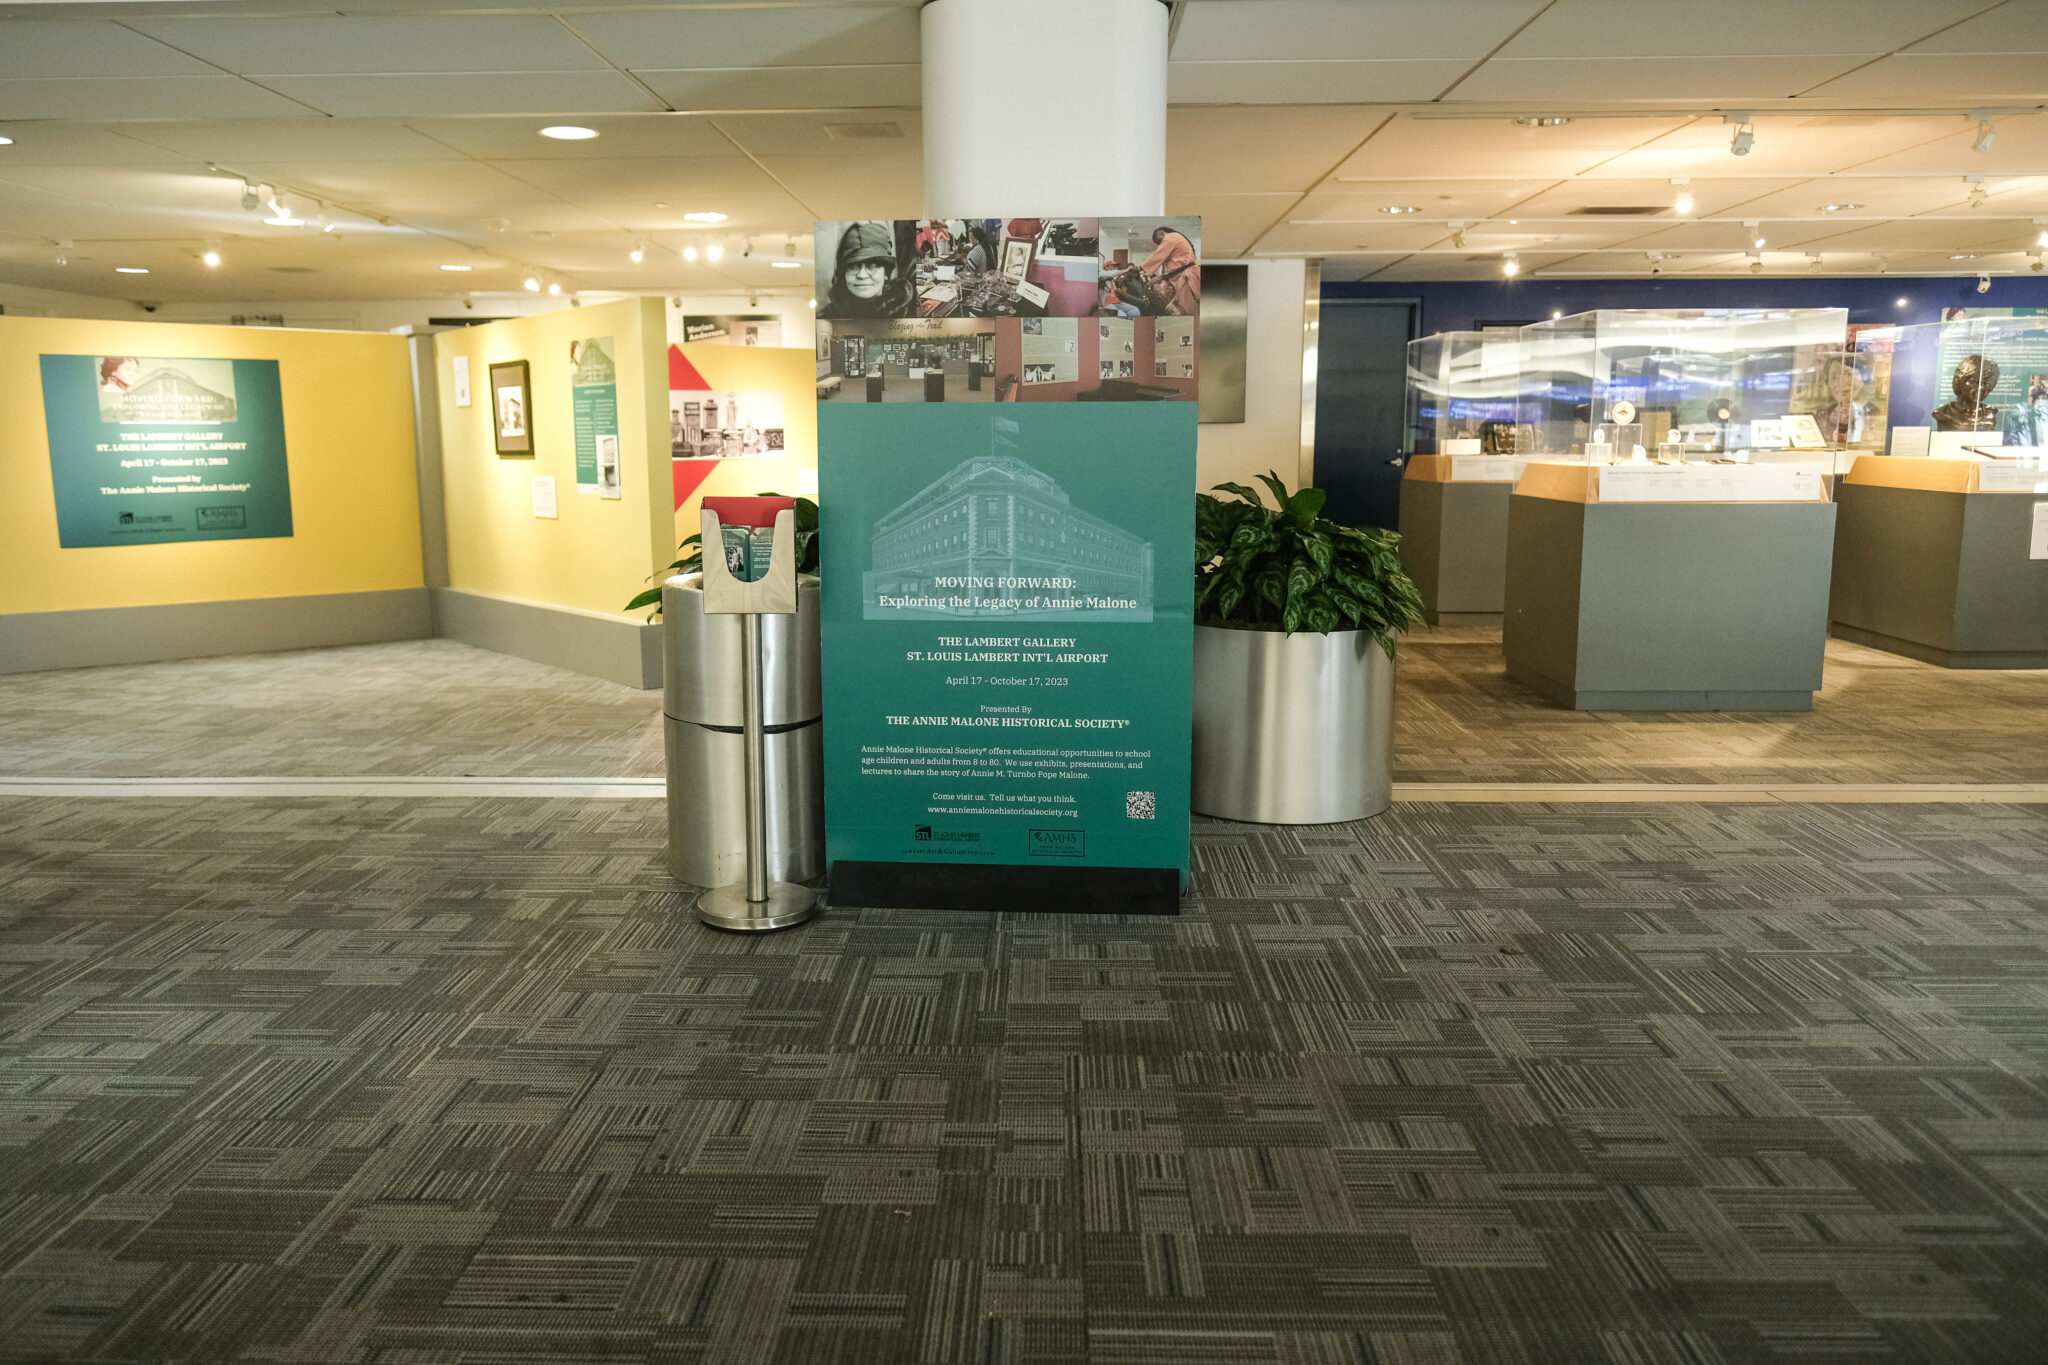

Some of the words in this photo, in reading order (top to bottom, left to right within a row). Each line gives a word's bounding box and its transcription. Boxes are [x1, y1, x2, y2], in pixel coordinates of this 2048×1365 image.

[687, 324, 715, 334] Marian
[888, 319, 914, 332] Blazing
[925, 319, 943, 329] Trail
[689, 329, 726, 341] Anderson
[120, 433, 141, 441] THE
[141, 433, 183, 441] LAMBERT
[184, 432, 223, 440] GALLERY
[96, 444, 112, 452] ST.
[141, 443, 184, 451] LAMBERT
[209, 442, 247, 450] AIRPORT
[121, 459, 143, 468] April
[144, 459, 154, 467] 17
[161, 458, 193, 467] October
[195, 458, 208, 467] 17,
[152, 475, 191, 483] Presented
[191, 475, 201, 483] by
[101, 487, 118, 495] The
[120, 486, 145, 494] Annie
[934, 576, 994, 588] MOVING
[997, 577, 1076, 589] FORWARD:
[879, 595, 946, 610] Exploring
[948, 596, 971, 607] the
[974, 596, 1022, 611] Legacy
[1025, 596, 1040, 608] of
[1041, 596, 1083, 608] Annie
[1086, 597, 1137, 609] Malone
[937, 637, 962, 646] THE
[964, 638, 1021, 647] LAMBERT
[1022, 638, 1076, 647] GALLERY
[906, 652, 925, 661] ST.
[926, 652, 962, 661] LOUIS
[964, 653, 1020, 662] LAMBERT
[1022, 653, 1053, 662] INT'L
[1055, 654, 1109, 663] AIRPORT
[945, 676, 969, 687] April
[970, 677, 983, 685] 17
[989, 677, 1027, 686] October
[1028, 678, 1043, 686] 17,
[1044, 678, 1069, 686] 2023
[980, 705, 1020, 713] Presented
[1021, 706, 1032, 715] By
[885, 716, 910, 725] THE
[911, 717, 948, 725] ANNIE
[950, 717, 999, 726] MALONE
[1001, 718, 1072, 727] HISTORICAL
[860, 745, 885, 753] Annie
[885, 746, 914, 754] Malone
[915, 746, 954, 754] Historical
[988, 747, 1011, 755] offers
[1012, 748, 1059, 756] educational
[1059, 749, 1114, 758] opportunities
[1124, 750, 1151, 758] school
[860, 758, 875, 766] age
[909, 757, 925, 765] and
[926, 757, 951, 765] adults
[951, 758, 971, 766] from
[1004, 759, 1018, 767] We
[1033, 760, 1068, 768] exhibits,
[1069, 761, 1126, 770] presentations,
[1127, 761, 1143, 769] and
[861, 767, 893, 775] lectures
[902, 768, 925, 776] share
[940, 770, 961, 778] story
[961, 769, 971, 777] of
[1006, 770, 1037, 778] Turnbo
[1037, 771, 1058, 780] Pope
[1058, 771, 1090, 779] Malone.
[955, 793, 973, 801] visit
[988, 794, 1005, 802] Tell
[1016, 794, 1036, 802] what
[1053, 795, 1077, 803] think.
[927, 807, 1078, 817] www.anniemalonehistoricalsociety.org
[916, 832, 931, 840] STL
[1044, 832, 1078, 844] AMHS
